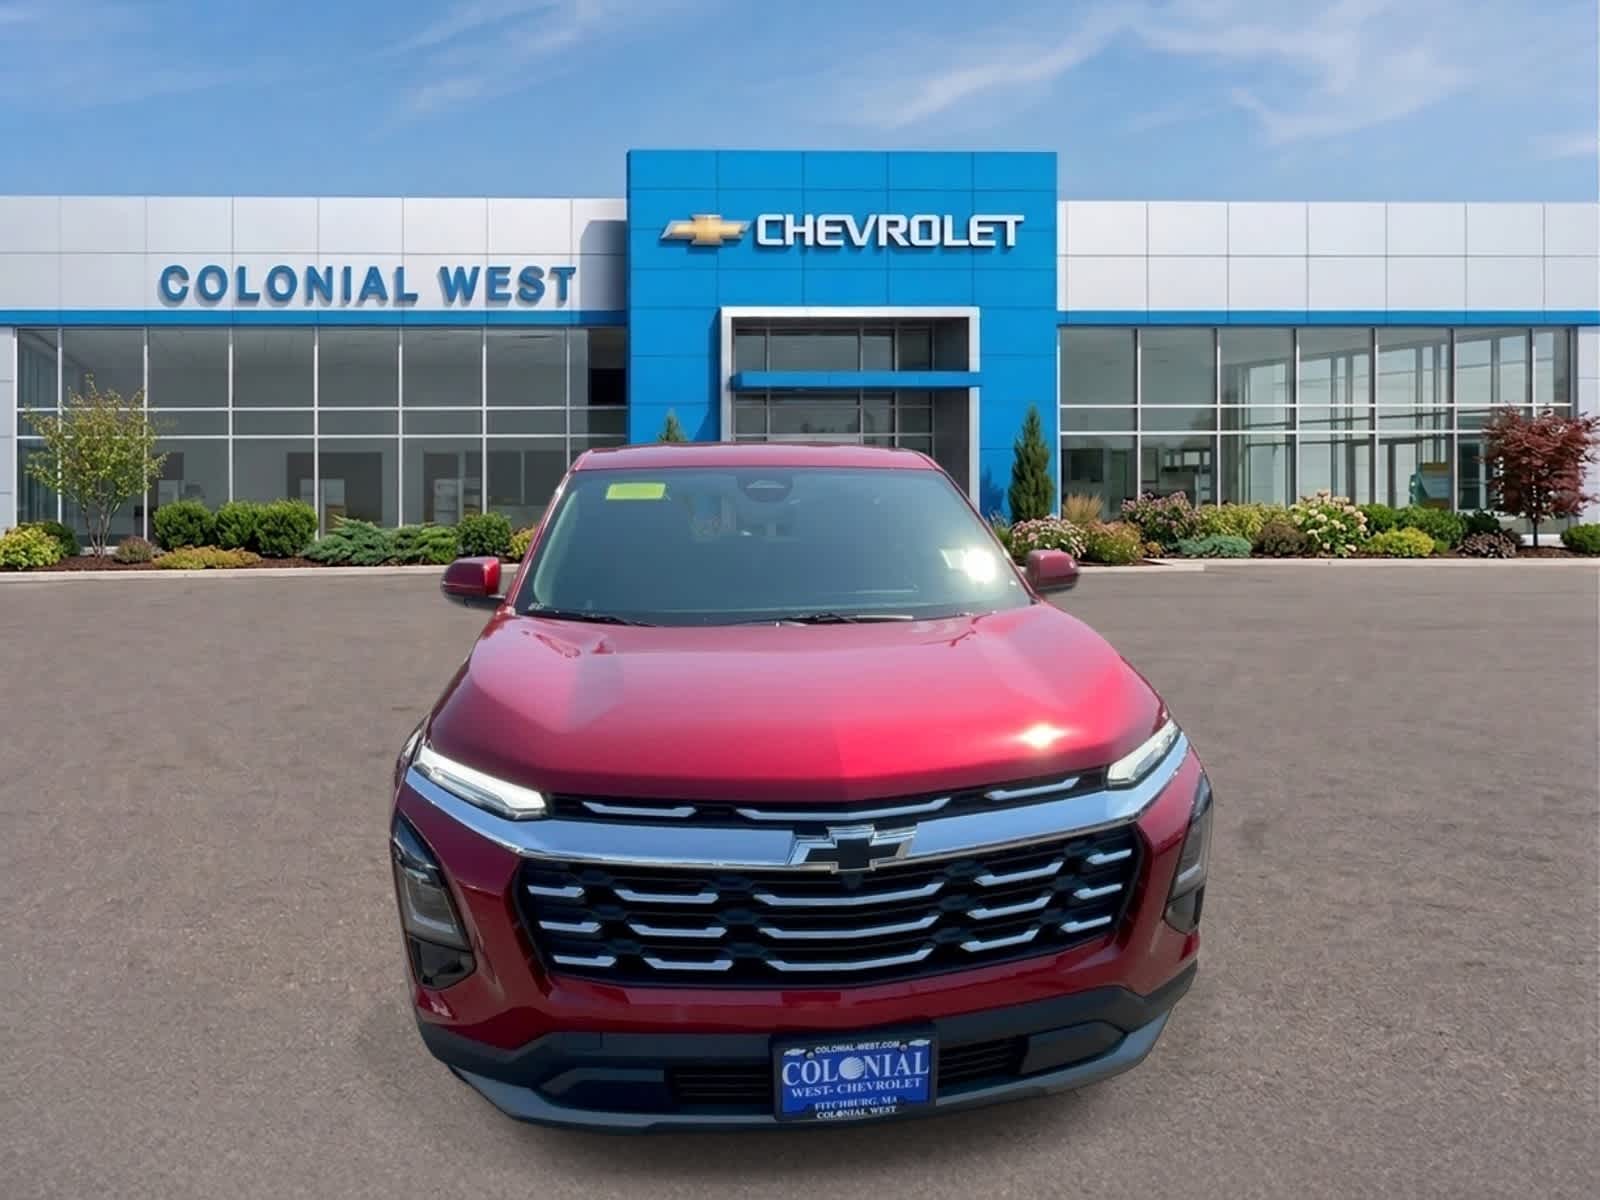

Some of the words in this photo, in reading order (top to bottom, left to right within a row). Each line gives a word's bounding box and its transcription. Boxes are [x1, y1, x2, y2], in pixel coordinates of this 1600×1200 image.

[757, 214, 1025, 247] CHEVROLET
[159, 265, 418, 307] COLONIAL
[437, 266, 577, 306] WEST
[814, 1040, 901, 1054] COLONIAL-WEST.COM
[782, 1052, 929, 1086] COLONIAL
[836, 1077, 923, 1094] CHEVROLET
[881, 1096, 898, 1105] MA
[816, 1108, 866, 1120] COLONIAL
[870, 1106, 897, 1116] WEST
